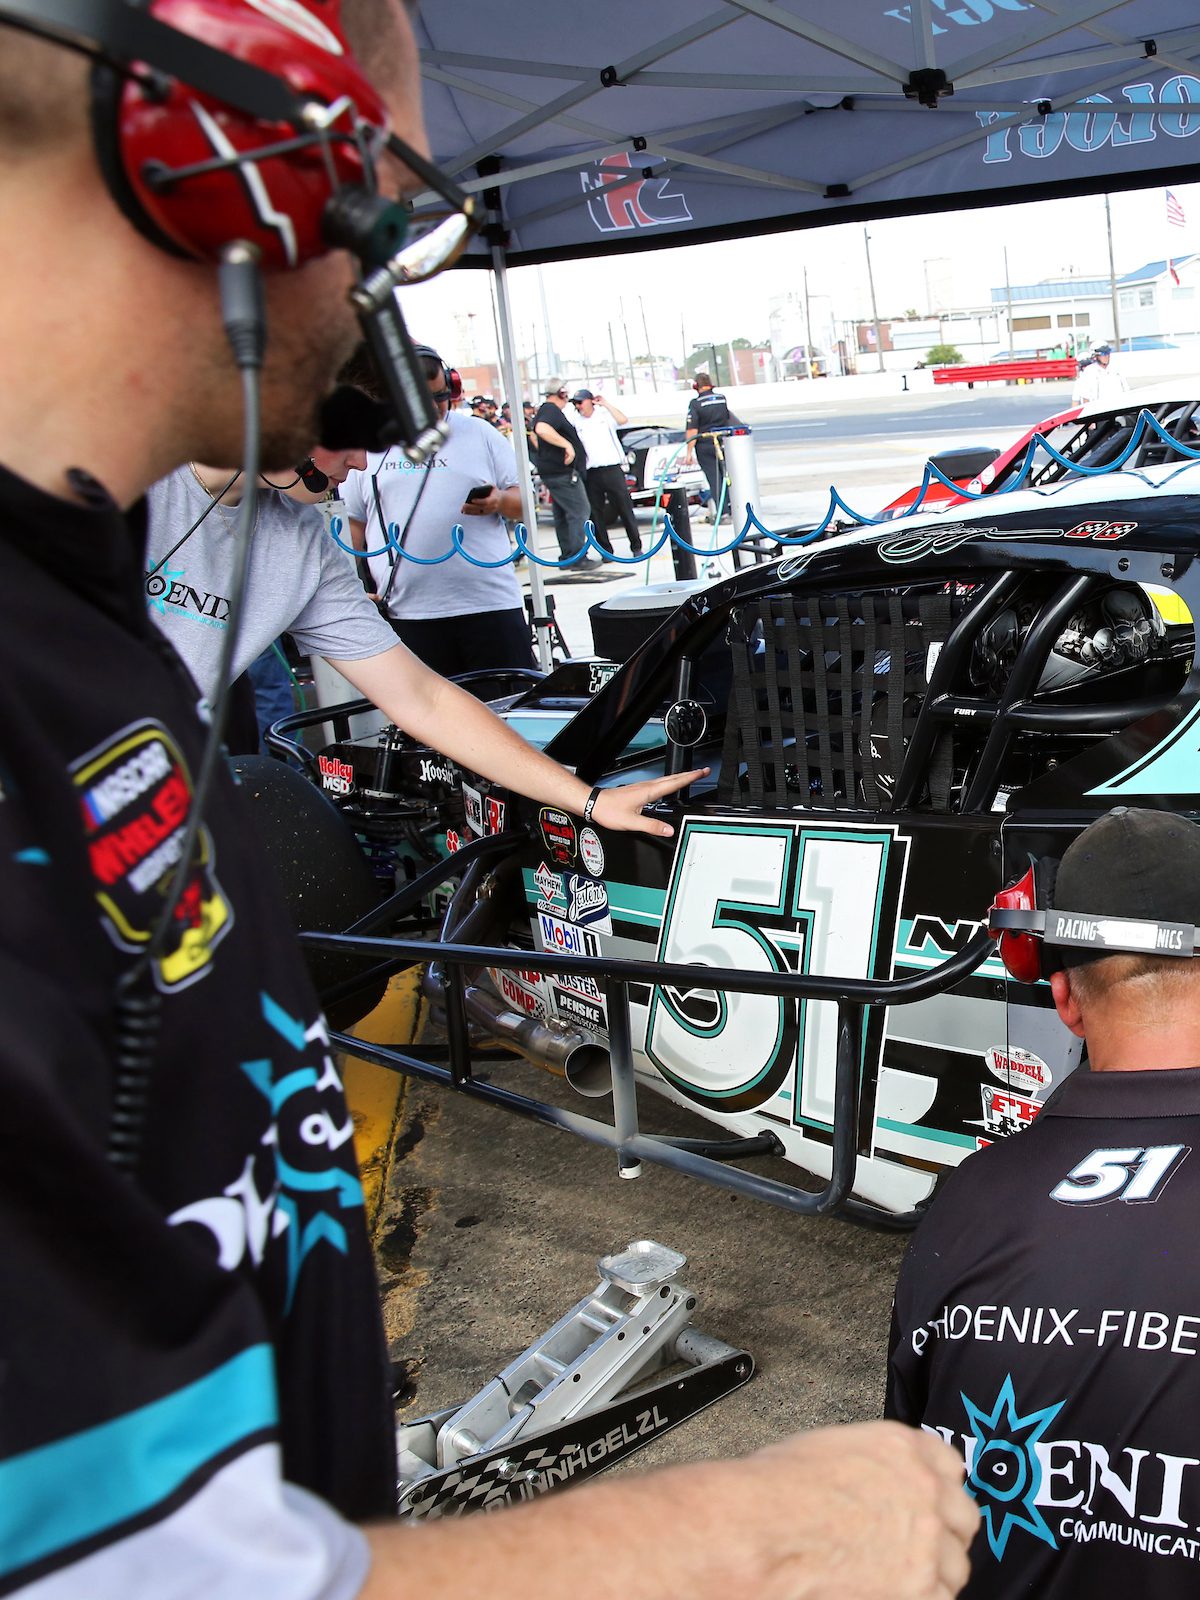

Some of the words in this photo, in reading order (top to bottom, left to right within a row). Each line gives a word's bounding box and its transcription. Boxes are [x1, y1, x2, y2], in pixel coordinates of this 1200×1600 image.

[901, 375, 909, 391] 1
[953, 707, 977, 716] FURY
[319, 755, 353, 783] Holley
[323, 777, 350, 793] MSD
[534, 874, 562, 891] MAYHEW
[569, 874, 607, 921] Jostens
[541, 915, 581, 953] Mobil
[1056, 917, 1096, 941] RACING
[559, 974, 599, 998] MASTER
[645, 820, 895, 1136] 51
[501, 975, 537, 1013] COMP
[560, 995, 599, 1023] PENSKE
[994, 1052, 1044, 1083] WADDELL
[1049, 1144, 1192, 1207] 51
[472, 1405, 669, 1516] RUNNHOELZL
